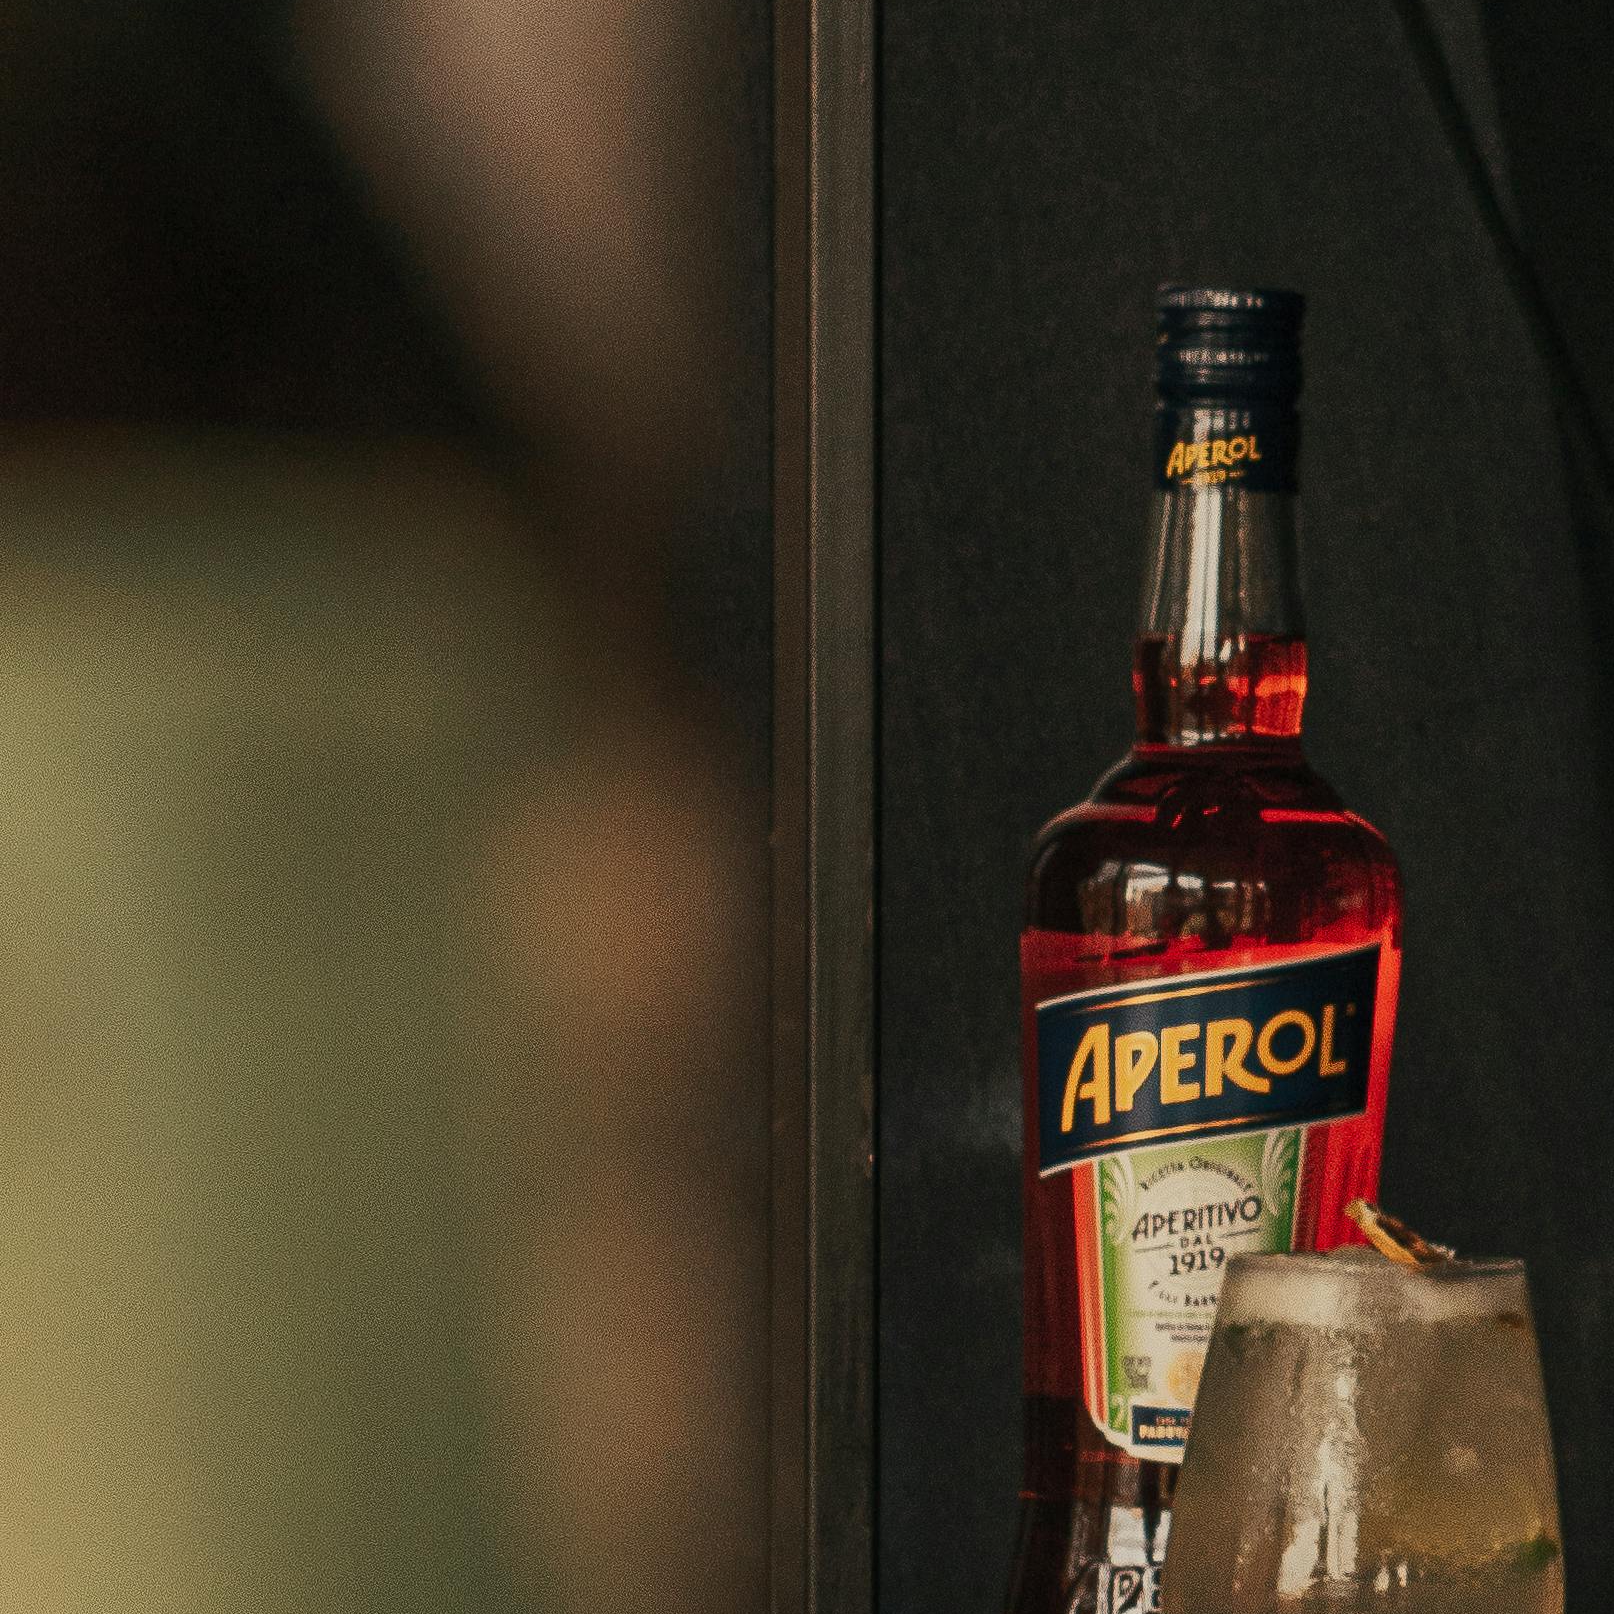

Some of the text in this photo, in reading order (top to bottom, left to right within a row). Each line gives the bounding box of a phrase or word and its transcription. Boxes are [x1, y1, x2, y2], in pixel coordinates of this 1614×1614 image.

[1164, 434, 1263, 479] APEROL
[1060, 1003, 1348, 1134] APEROL
[1132, 1194, 1262, 1242] APERITIVO
[1169, 1246, 1226, 1276] 1919
[1180, 1234, 1213, 1249] DAL
